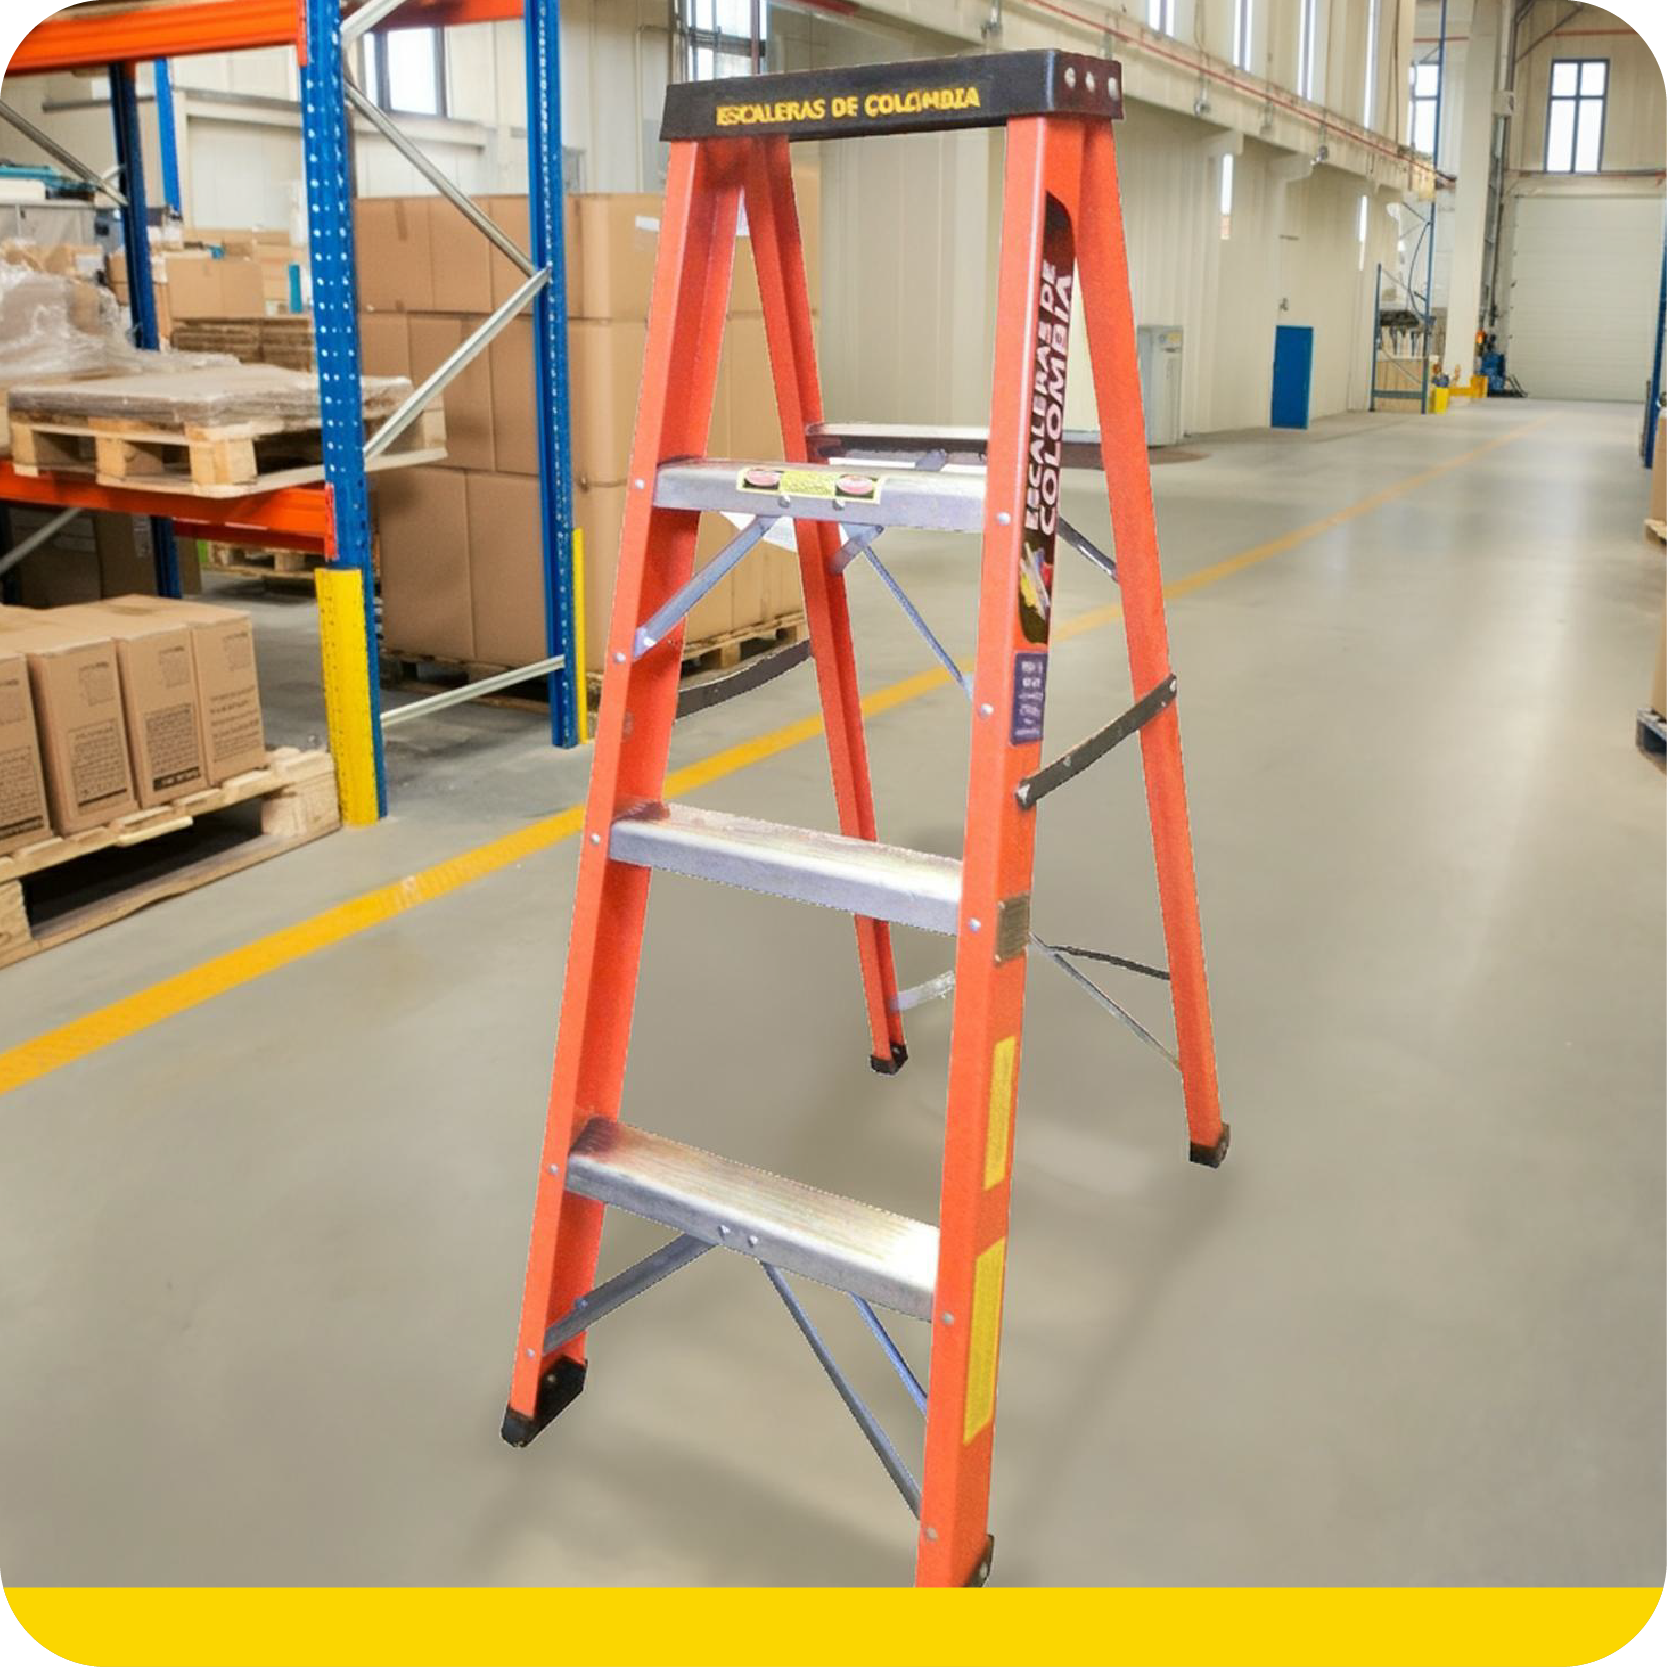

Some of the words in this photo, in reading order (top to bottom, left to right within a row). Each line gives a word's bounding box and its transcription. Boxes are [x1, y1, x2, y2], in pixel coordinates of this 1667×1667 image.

[716, 100, 826, 126] ESCALERAS
[831, 95, 859, 118] DE
[1041, 275, 1073, 536] COLOMBIA
